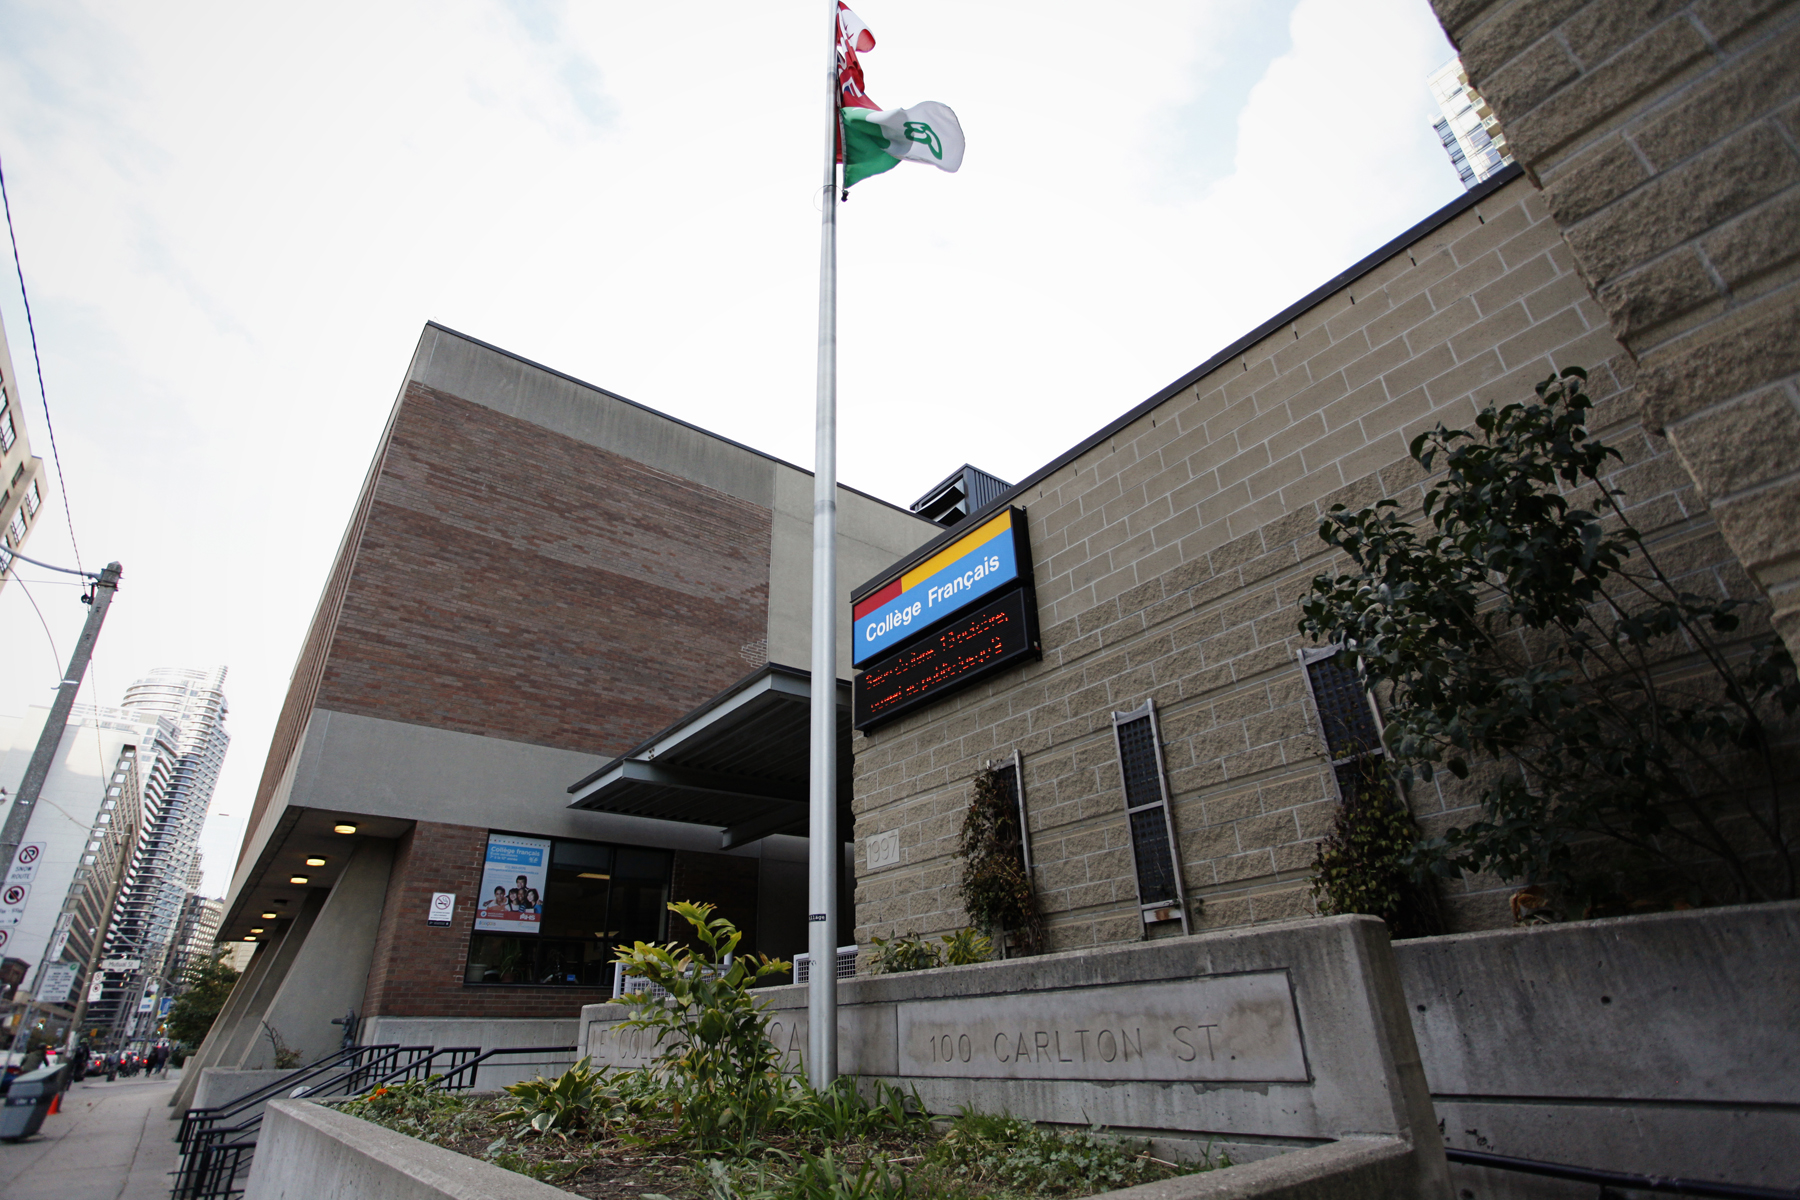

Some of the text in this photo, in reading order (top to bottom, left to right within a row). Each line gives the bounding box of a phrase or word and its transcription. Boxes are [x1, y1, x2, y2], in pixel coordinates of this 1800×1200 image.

[866, 556, 1000, 642] Collège Français
[490, 846, 540, 857] Collège français
[867, 834, 898, 863] 1997
[592, 1028, 607, 1059] LE
[929, 1024, 1237, 1063] 100 CARLTON ST.
